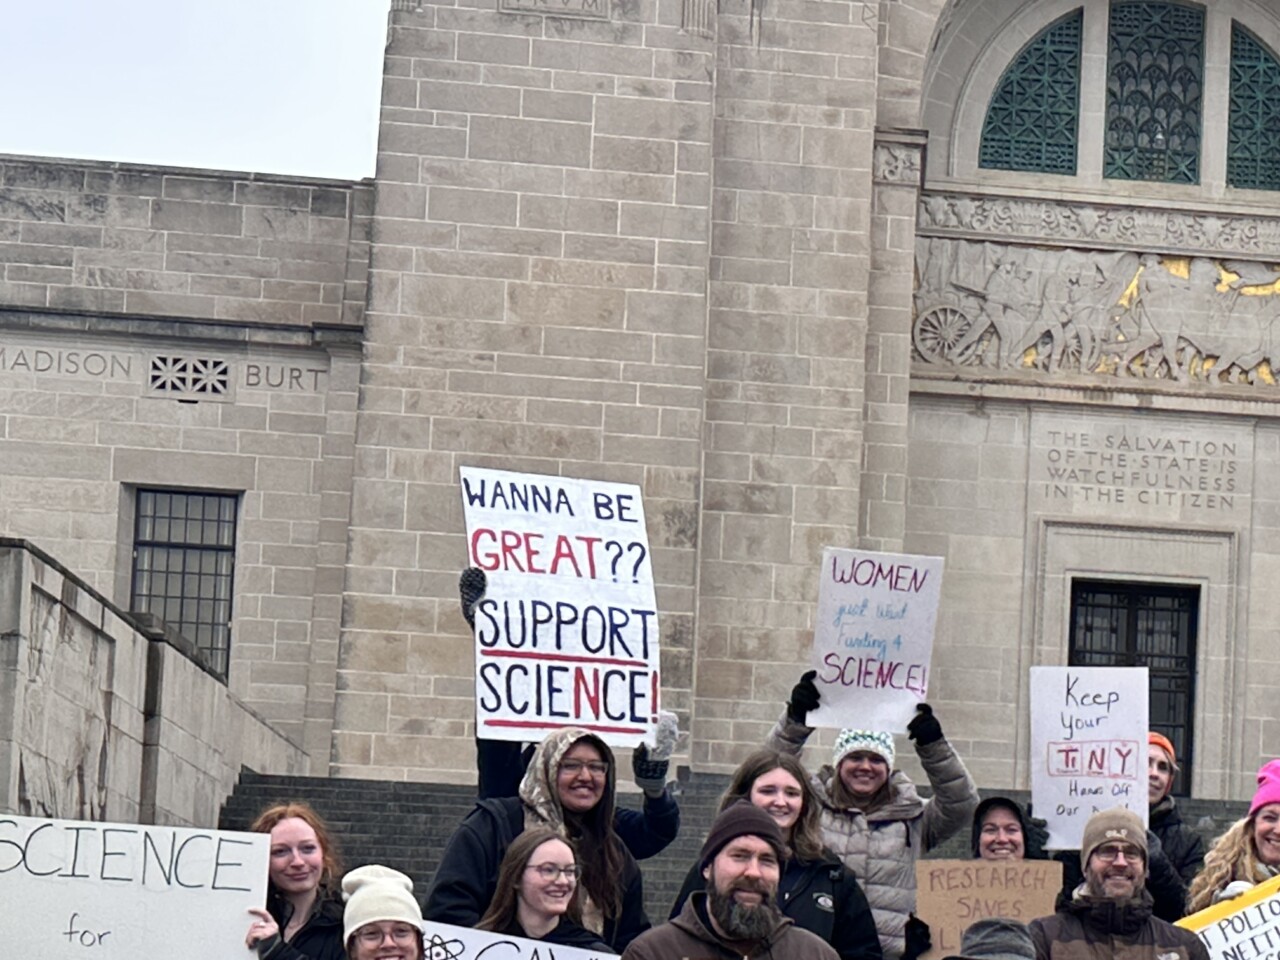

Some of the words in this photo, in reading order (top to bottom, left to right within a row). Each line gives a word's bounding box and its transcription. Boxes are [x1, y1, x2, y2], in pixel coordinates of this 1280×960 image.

[245, 364, 328, 392] BURT
[1047, 430, 1089, 447] THE
[1105, 434, 1237, 456] SALVATION
[1047, 448, 1076, 464] OF
[1084, 451, 1127, 468] THE
[1140, 454, 1209, 473] STATE
[1219, 460, 1237, 475] IS
[1047, 466, 1236, 492] WATCHFULNESS
[463, 477, 575, 517] WANNA
[593, 492, 639, 523] BE
[1045, 483, 1068, 498] IN
[1081, 486, 1125, 504] THE
[1138, 490, 1234, 510] CITIZEN
[471, 528, 646, 584] GREAT??
[832, 556, 929, 594] WOMEN
[479, 599, 656, 660] SUPPORT
[892, 634, 903, 651] 4
[819, 652, 927, 696] SCIENCE!
[480, 662, 659, 725] SCIENCE!
[1065, 672, 1120, 713] Keep
[0, 820, 254, 892] SCIENCE
[929, 866, 1047, 892] RESEARCH
[956, 897, 1023, 919] SAVES
[62, 912, 112, 947] for
